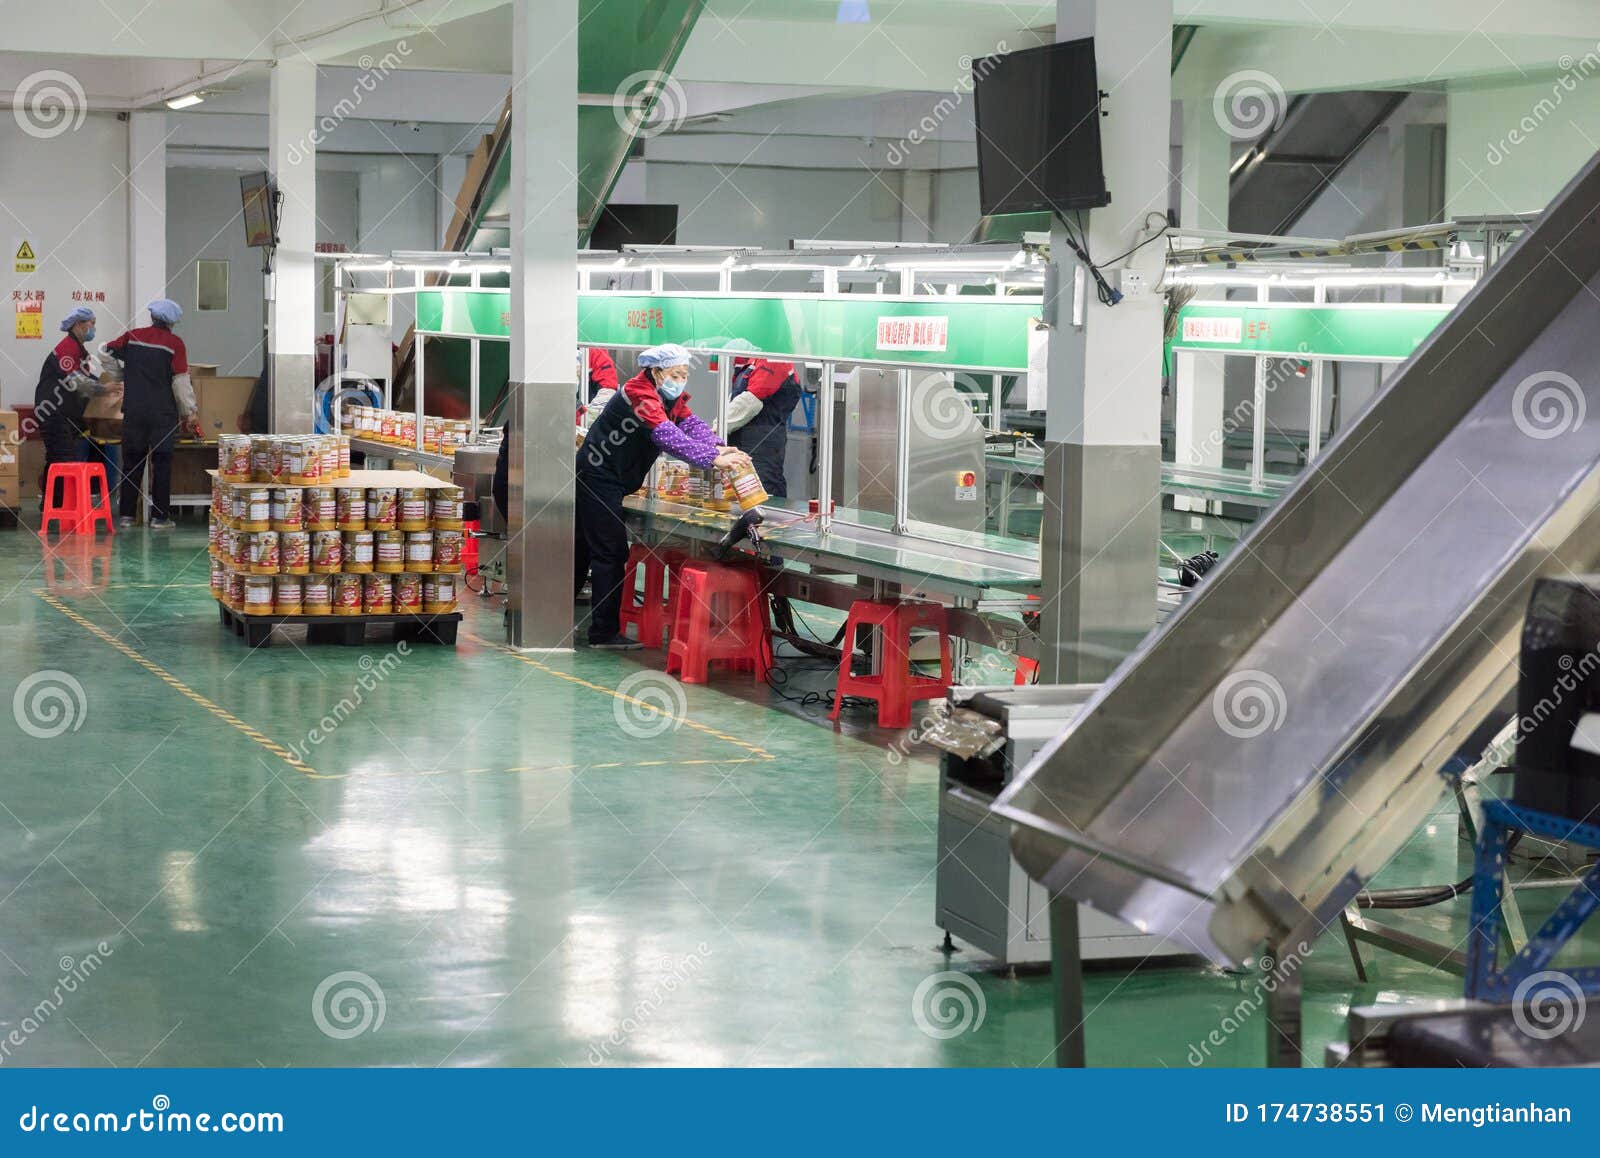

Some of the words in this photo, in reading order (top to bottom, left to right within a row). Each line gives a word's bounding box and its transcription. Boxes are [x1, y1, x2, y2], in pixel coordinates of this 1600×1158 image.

[12, 290, 46, 301] 灭火器
[72, 291, 105, 302] 垃圾桶
